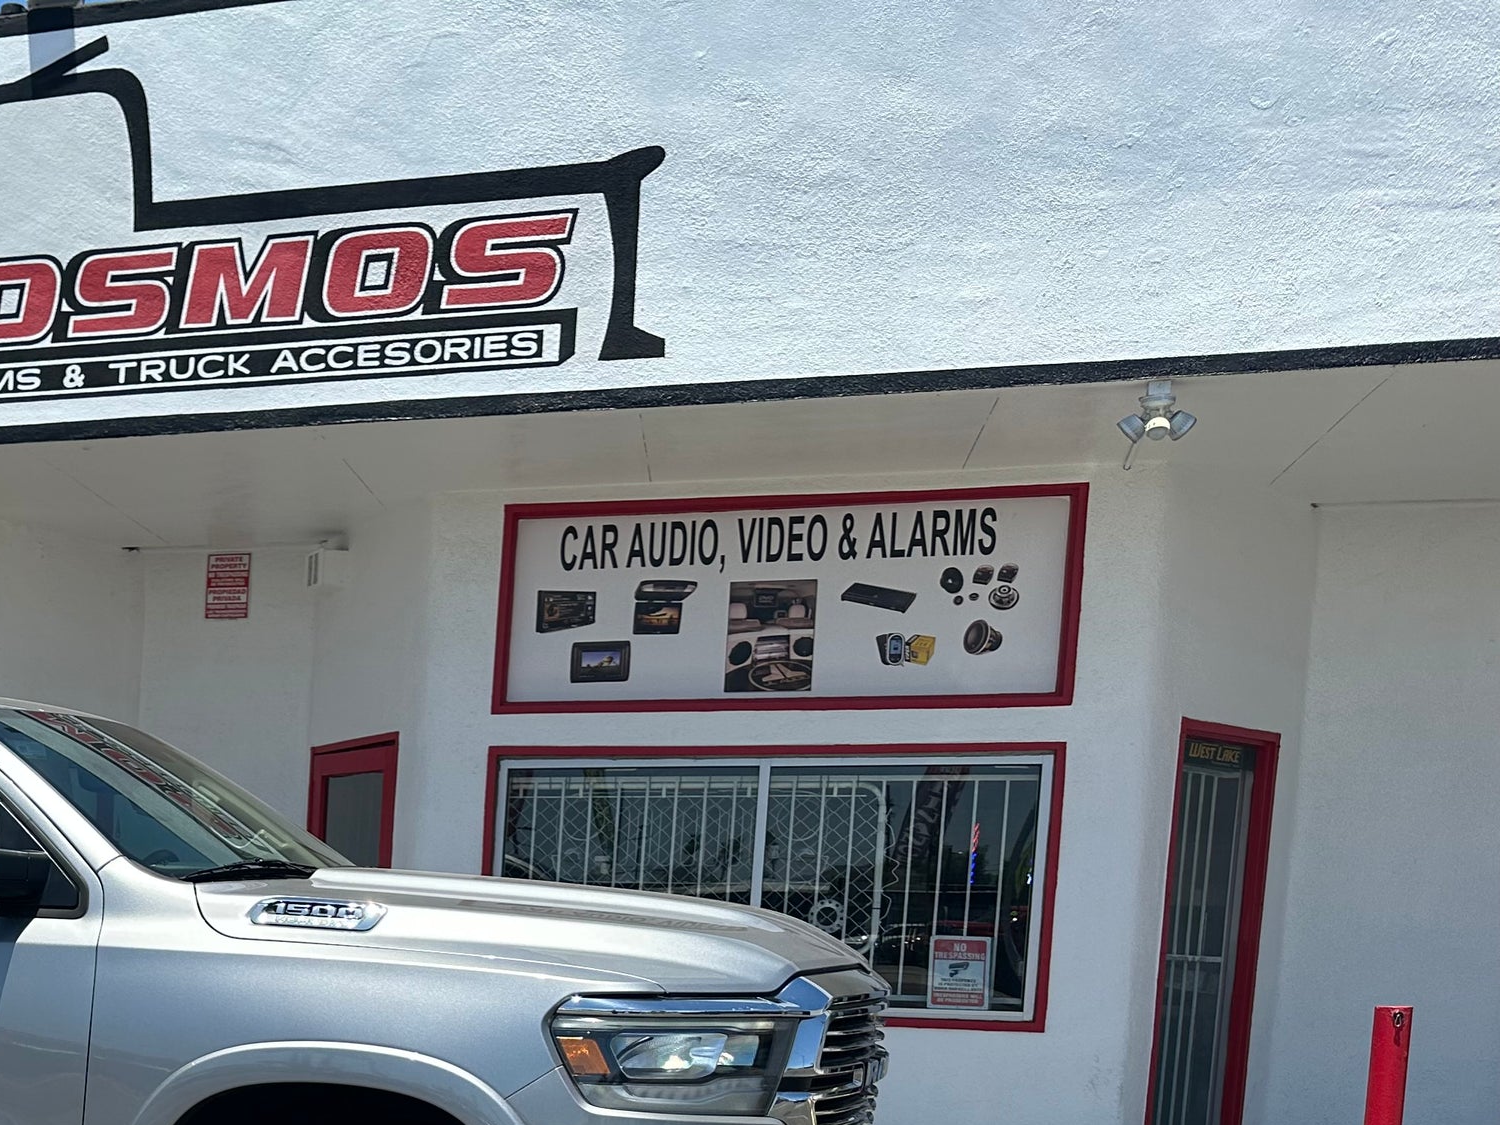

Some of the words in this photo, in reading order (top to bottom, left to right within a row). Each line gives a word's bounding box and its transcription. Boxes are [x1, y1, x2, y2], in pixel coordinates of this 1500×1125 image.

[62, 364, 86, 388] &
[108, 352, 252, 384] TRUCK
[270, 331, 539, 374] ACCESORIES
[560, 524, 619, 571] CAR
[626, 518, 726, 573] AUDIO,
[737, 514, 829, 564] VIDEO
[838, 512, 858, 561] &
[865, 507, 999, 559] ALARMS
[1188, 743, 1216, 760] WEST
[1216, 746, 1240, 763] LAKE
[274, 901, 365, 920] 1500
[934, 951, 985, 961] TRESPASSING
[953, 942, 967, 952] NO
